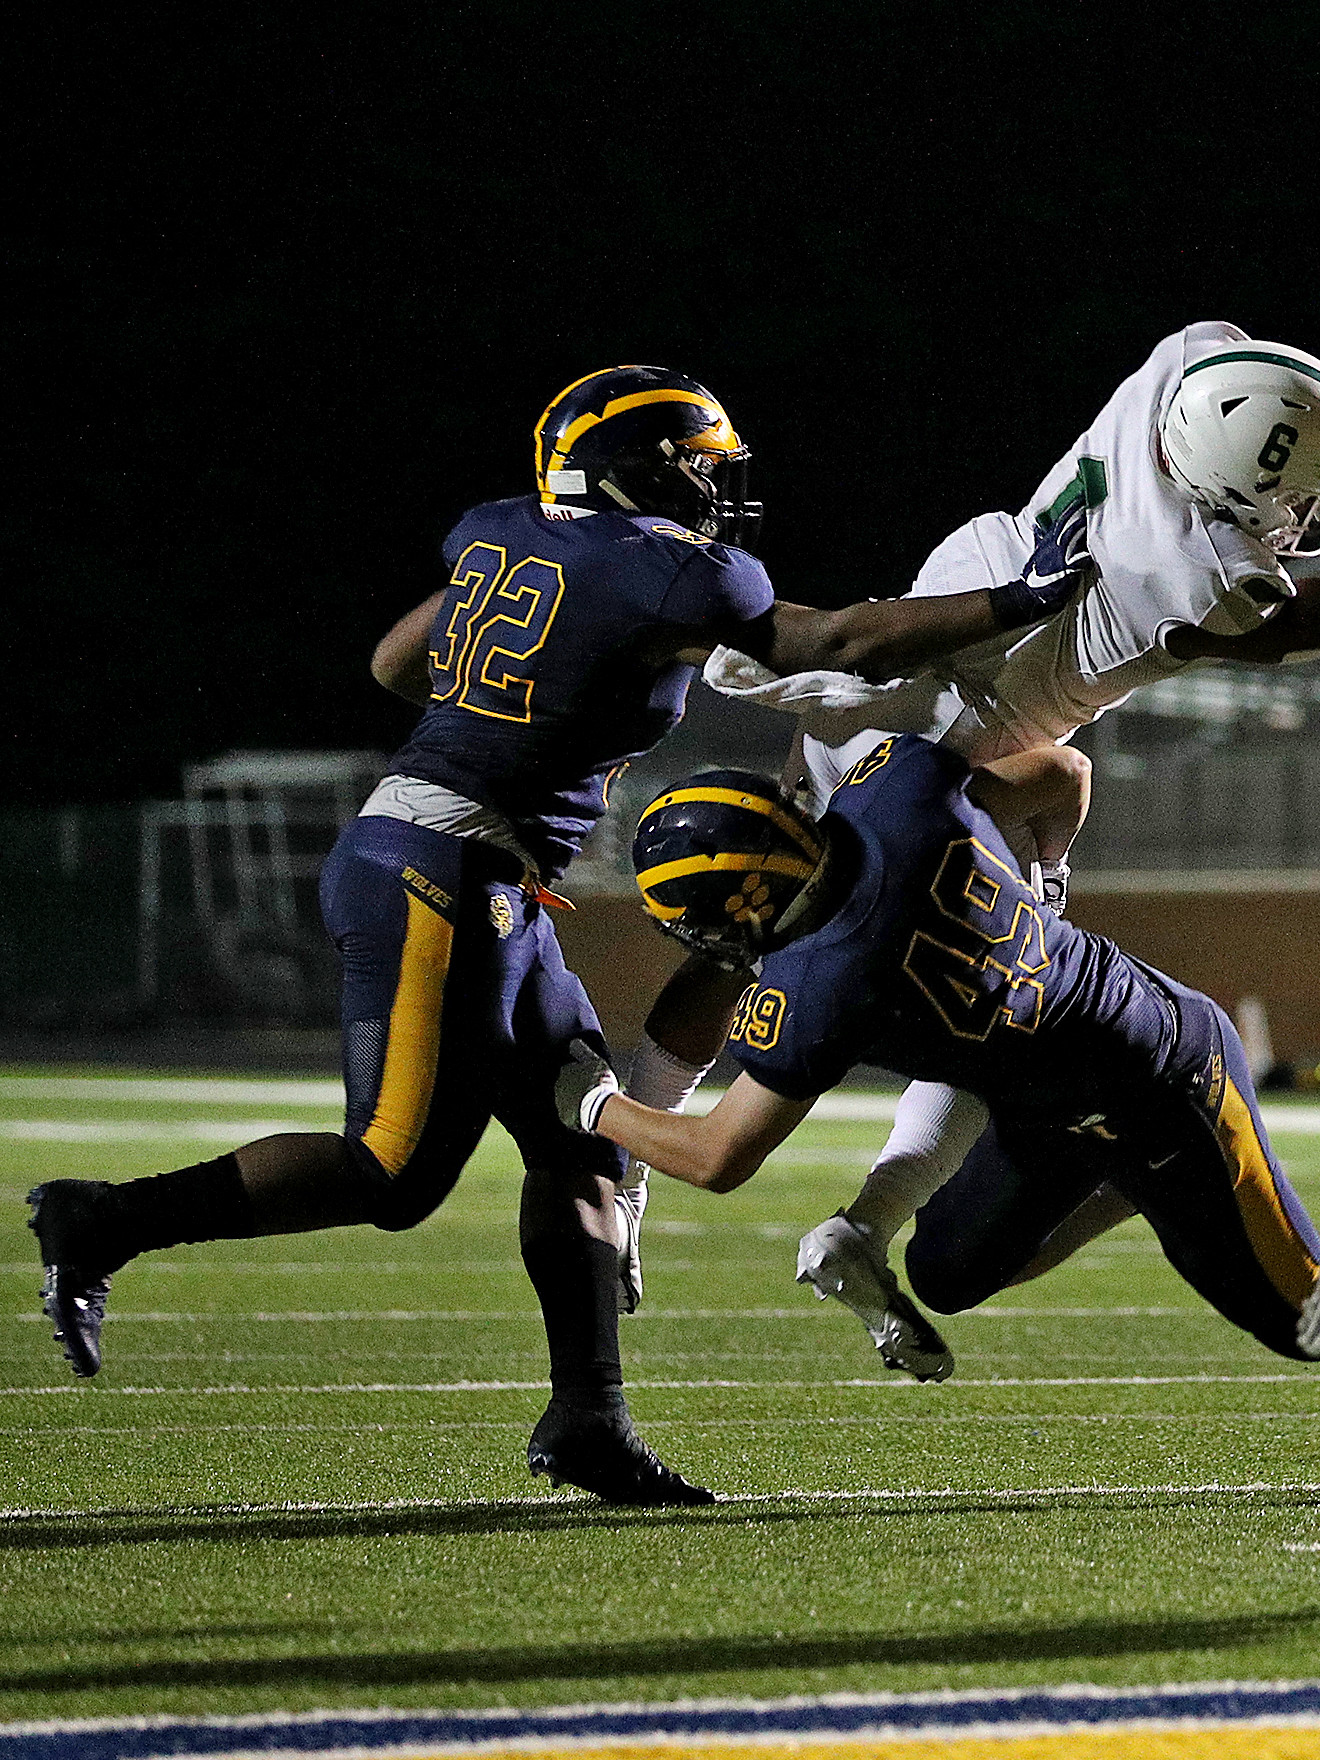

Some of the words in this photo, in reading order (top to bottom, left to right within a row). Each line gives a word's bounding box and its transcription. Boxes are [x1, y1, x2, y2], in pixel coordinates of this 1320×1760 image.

[1258, 421, 1299, 472] 6
[428, 541, 565, 723] 32
[401, 866, 453, 908] WOLVES
[902, 837, 1050, 1041] 49
[729, 983, 787, 1051] 49
